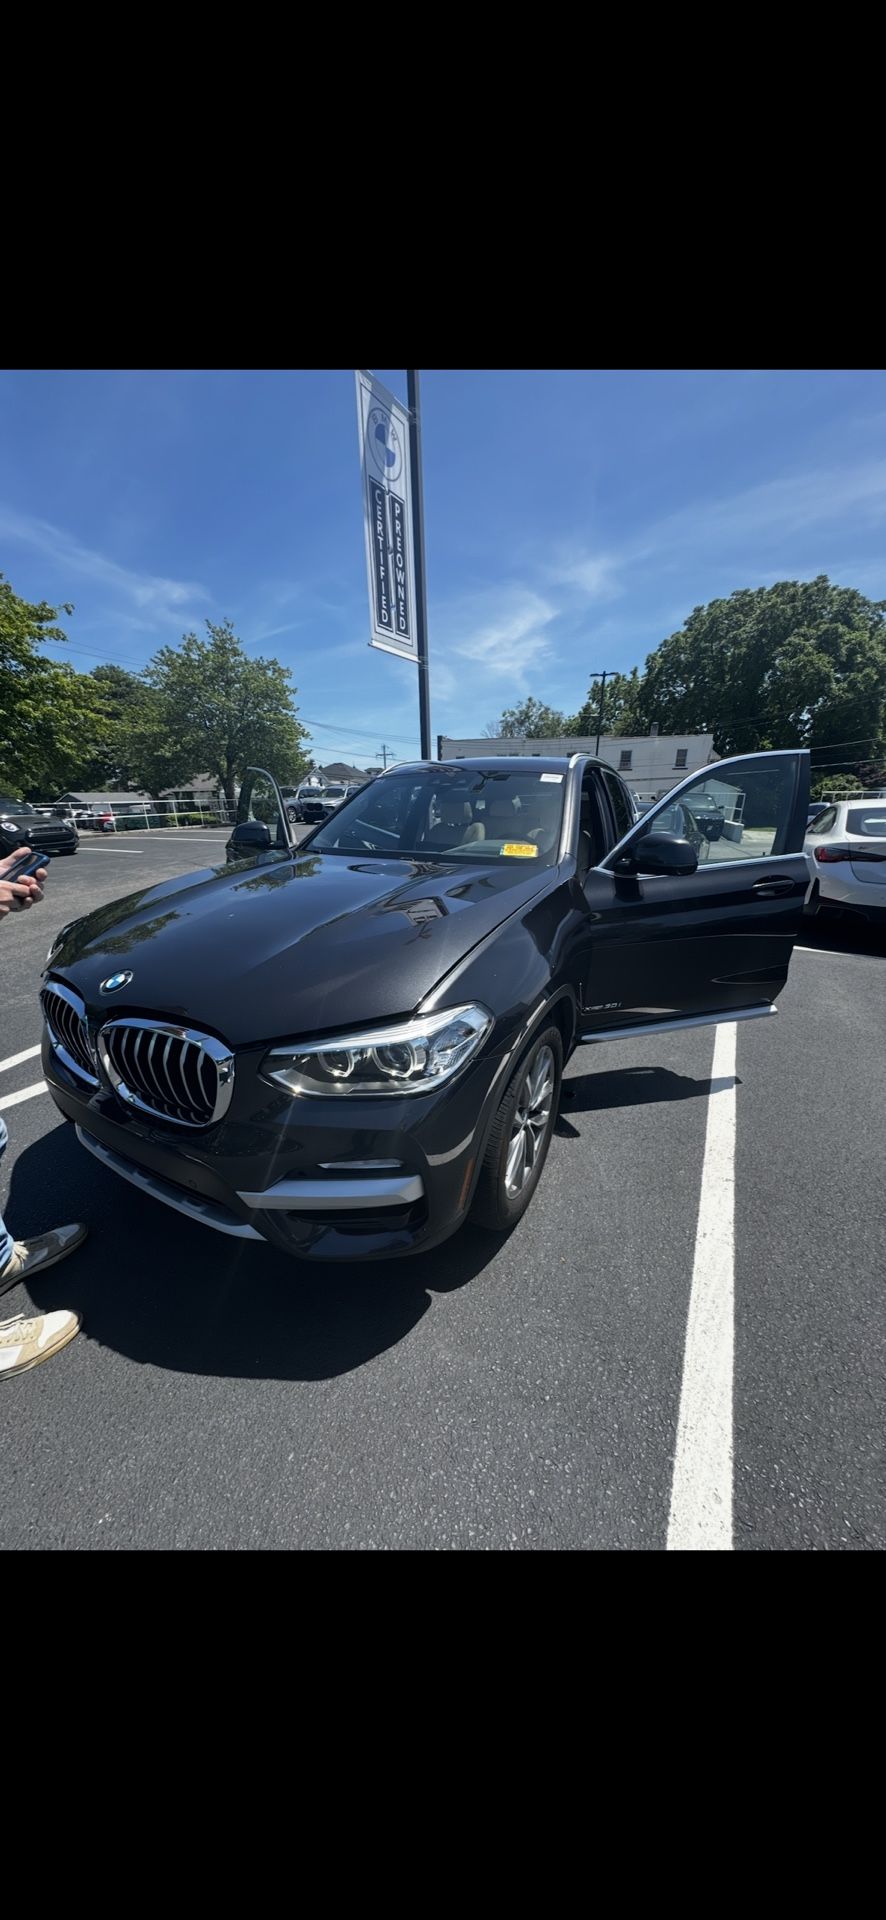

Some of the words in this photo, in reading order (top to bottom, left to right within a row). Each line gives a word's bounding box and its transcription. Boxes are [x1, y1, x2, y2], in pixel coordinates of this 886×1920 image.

[371, 412, 399, 441] BMW
[375, 489, 389, 623] CERTIFIED
[394, 502, 407, 630] PREOWNED
